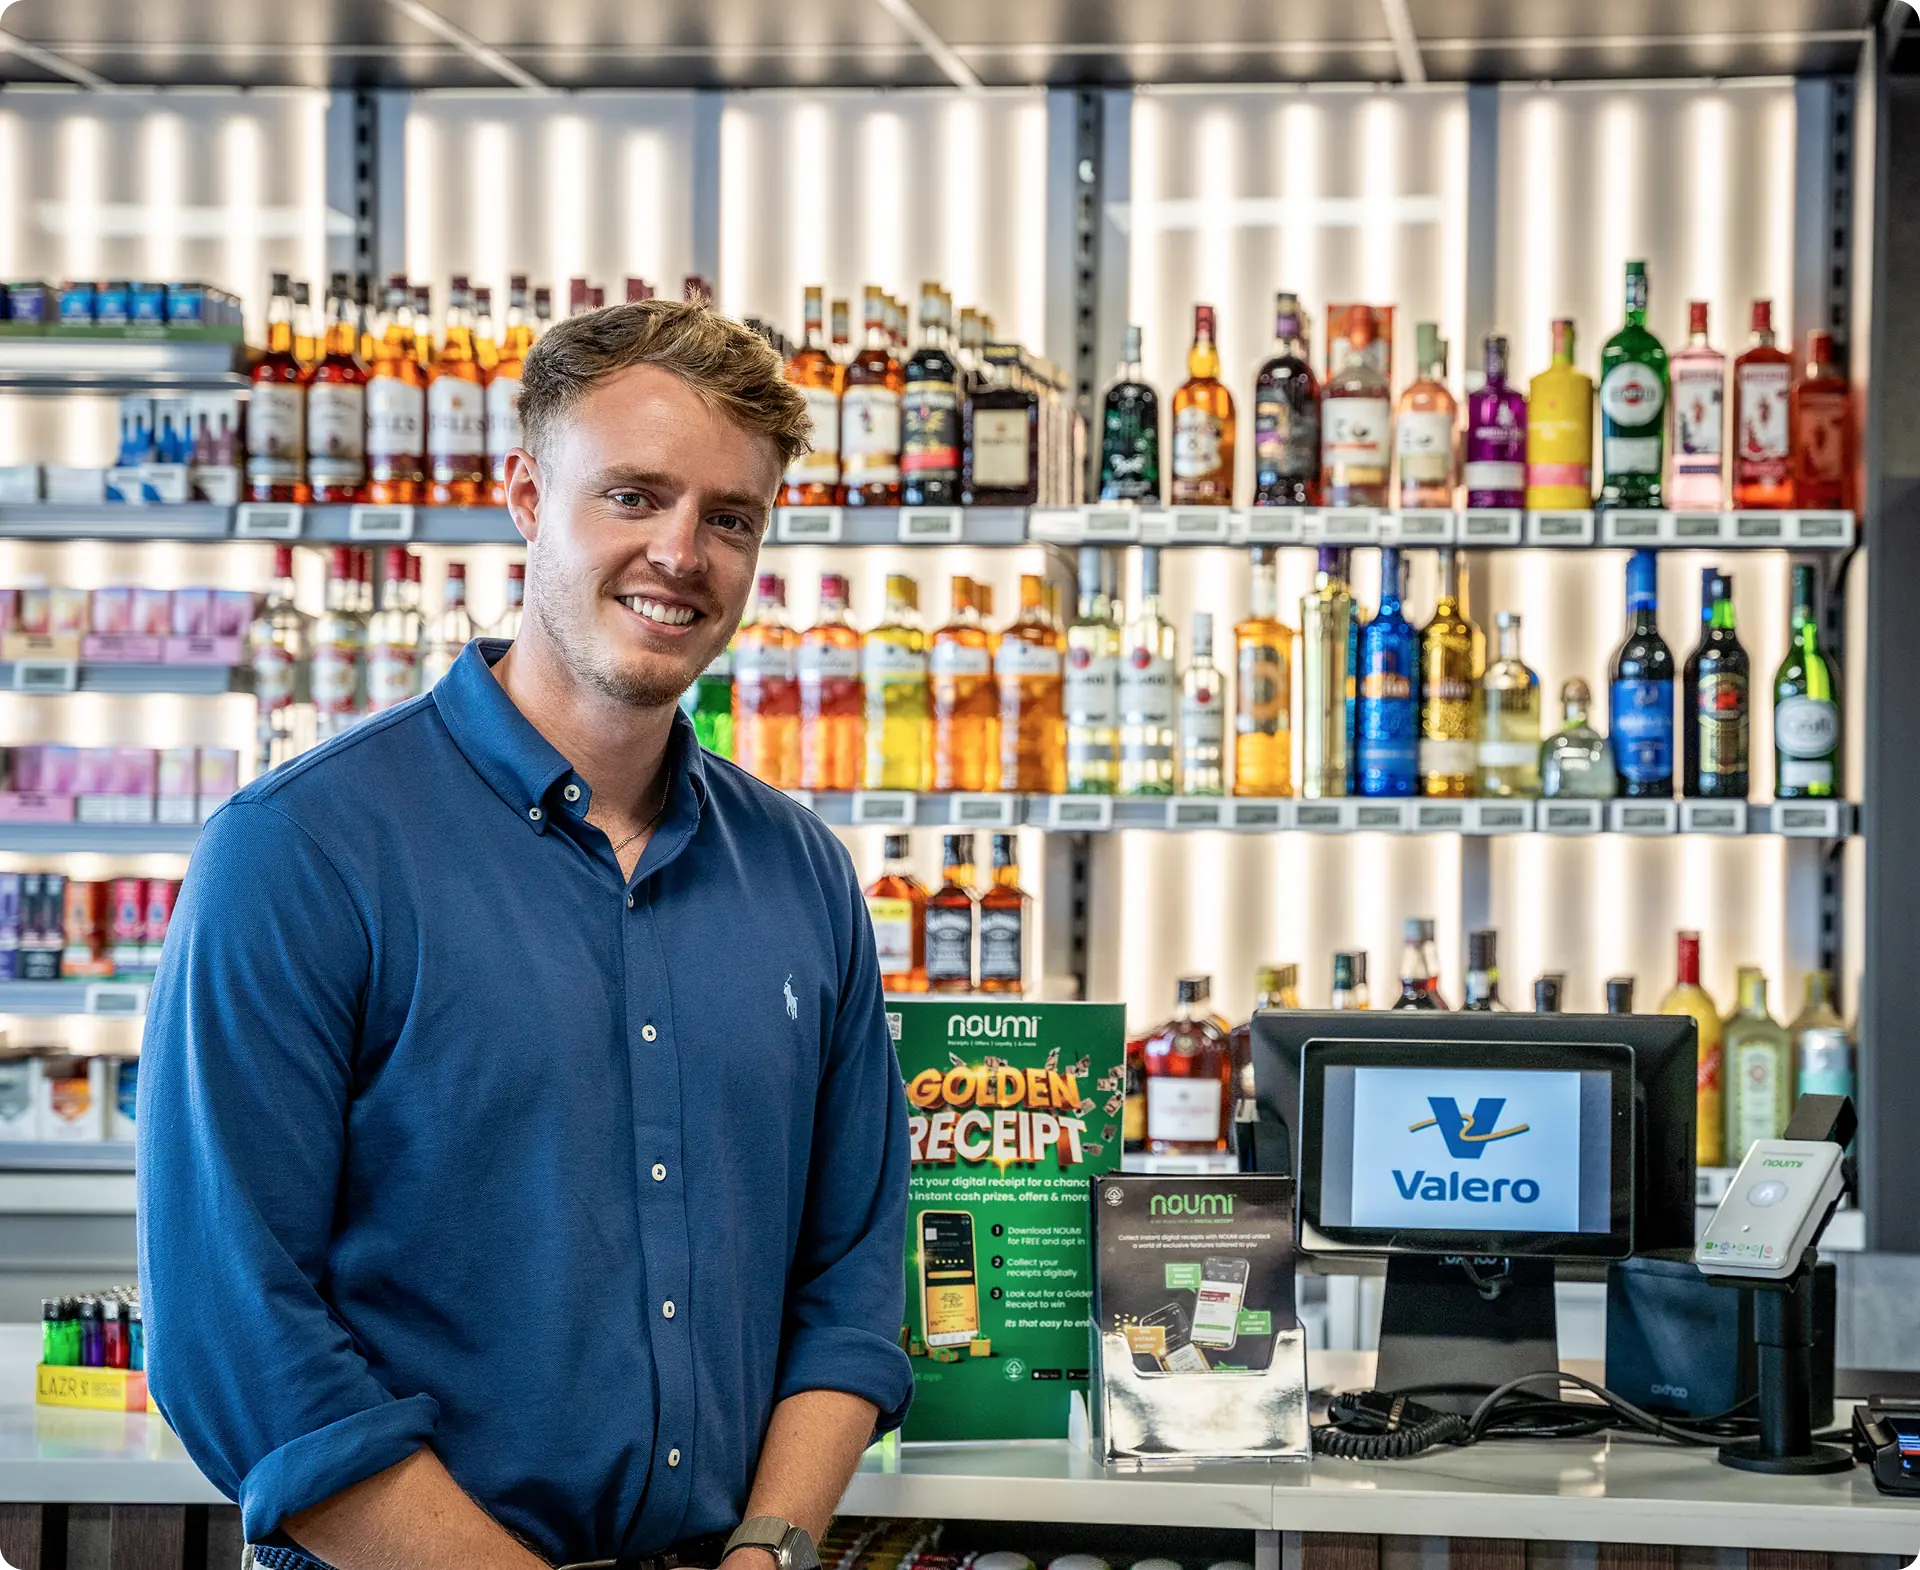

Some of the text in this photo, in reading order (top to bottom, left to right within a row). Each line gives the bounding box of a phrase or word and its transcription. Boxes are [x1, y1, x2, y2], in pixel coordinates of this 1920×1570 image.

[948, 1014, 1038, 1038] noumi
[906, 1066, 1081, 1109] GOLDEN
[910, 1110, 1087, 1164] RECEIPT
[1763, 1159, 1803, 1168] noumi
[926, 1178, 950, 1188] your
[952, 1176, 987, 1189] digital
[988, 1177, 1025, 1189] receipt
[1027, 1177, 1042, 1187] for
[1043, 1179, 1051, 1187] a
[1391, 1170, 1540, 1204] Valero
[915, 1191, 953, 1201] instant
[954, 1191, 981, 1201] cash
[982, 1191, 1017, 1204] prizes,
[1018, 1192, 1049, 1202] offers
[1051, 1192, 1059, 1202] &
[1150, 1194, 1233, 1215] noumi
[1008, 1226, 1051, 1235] Download
[1008, 1237, 1020, 1245] for
[1061, 1239, 1076, 1247] opt
[1077, 1237, 1086, 1245] in
[1039, 1260, 1059, 1268] your
[1006, 1269, 1078, 1279] receipts digitally
[1006, 1290, 1025, 1298] Look
[1043, 1290, 1056, 1298] for
[1005, 1300, 1038, 1310] Receipt
[1018, 1319, 1038, 1328] that
[1039, 1320, 1062, 1330] easy
[1063, 1320, 1073, 1328] to
[1074, 1320, 1089, 1328] ent
[39, 1375, 77, 1399] LAZR
